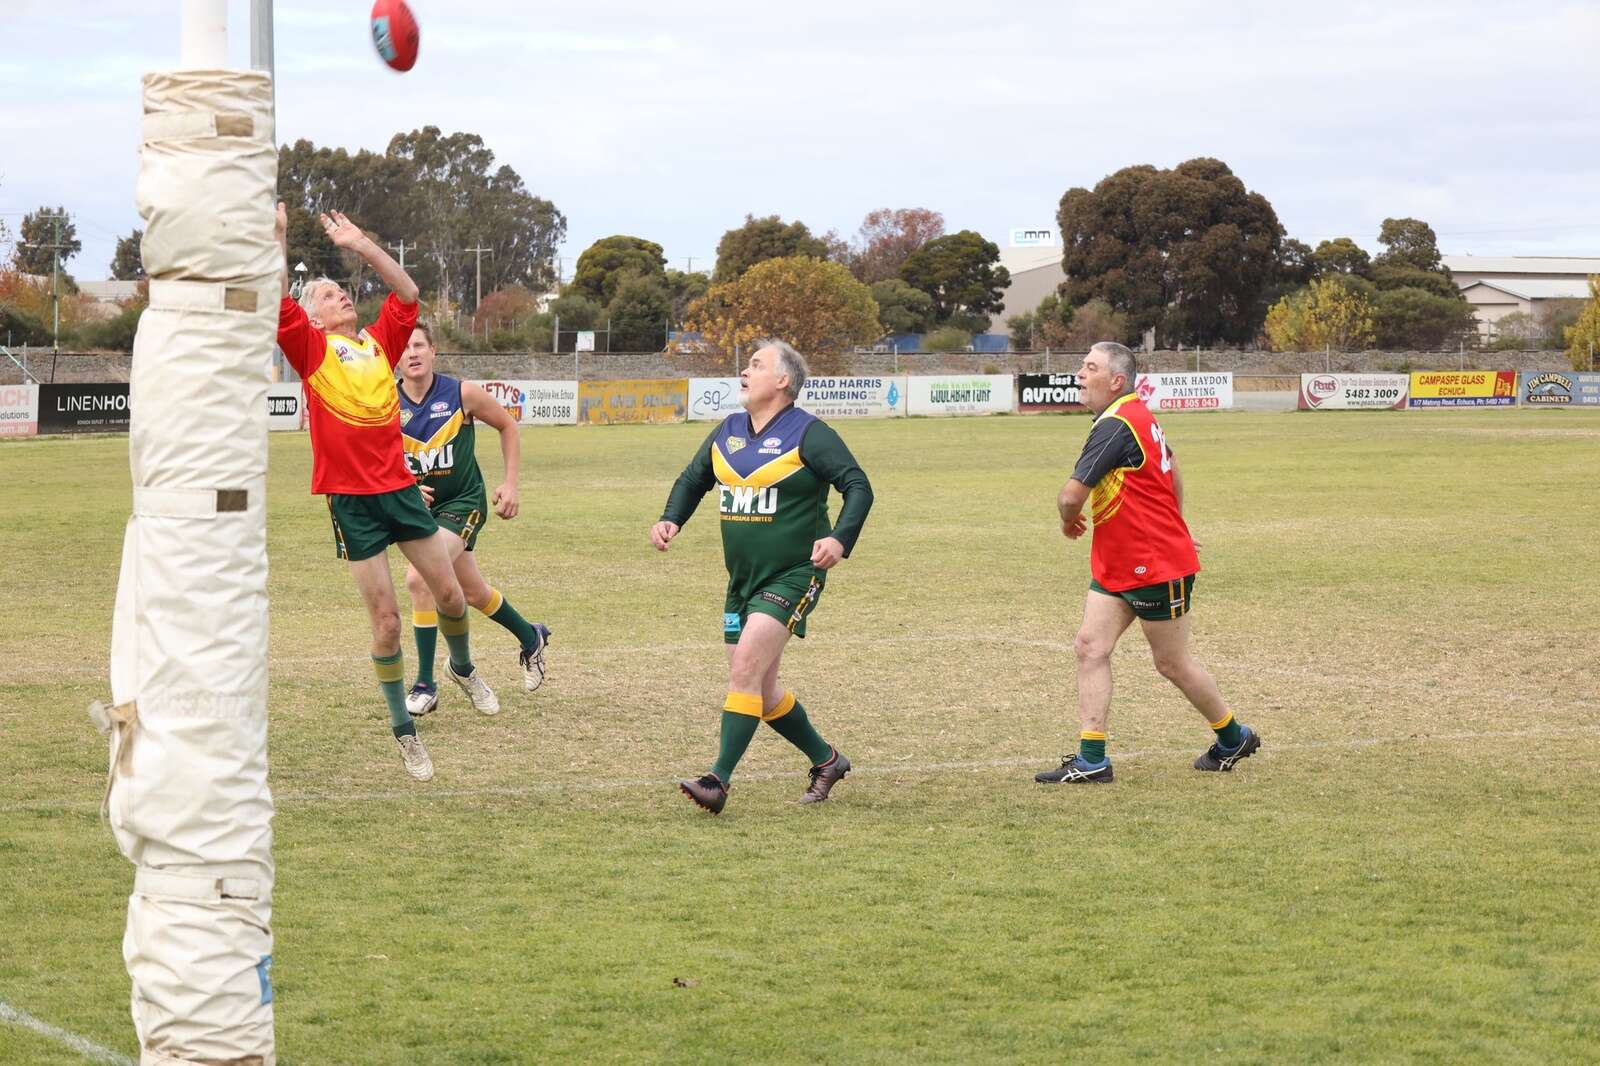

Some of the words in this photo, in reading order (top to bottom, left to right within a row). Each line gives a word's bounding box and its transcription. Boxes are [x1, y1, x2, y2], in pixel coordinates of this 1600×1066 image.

[804, 379, 836, 388] BRAD
[839, 379, 882, 388] HARRIS
[1049, 375, 1071, 385] East
[1161, 377, 1187, 386] MARK
[1191, 375, 1228, 385] HAYDON
[1420, 376, 1460, 385] CAMPASPE
[1461, 375, 1485, 384] GLASS
[1528, 377, 1540, 392] JIM
[1540, 373, 1572, 391] CAMPBELL
[807, 391, 867, 400] PLUMBING
[1023, 387, 1079, 403] AUTOM
[1173, 388, 1216, 397] PAINTING
[1345, 390, 1370, 398] 5482
[1374, 389, 1399, 398] 3009
[1161, 400, 1181, 408] 0418
[532, 405, 550, 418] 5480
[552, 405, 571, 417] 0588
[720, 485, 778, 514] E.M.U
